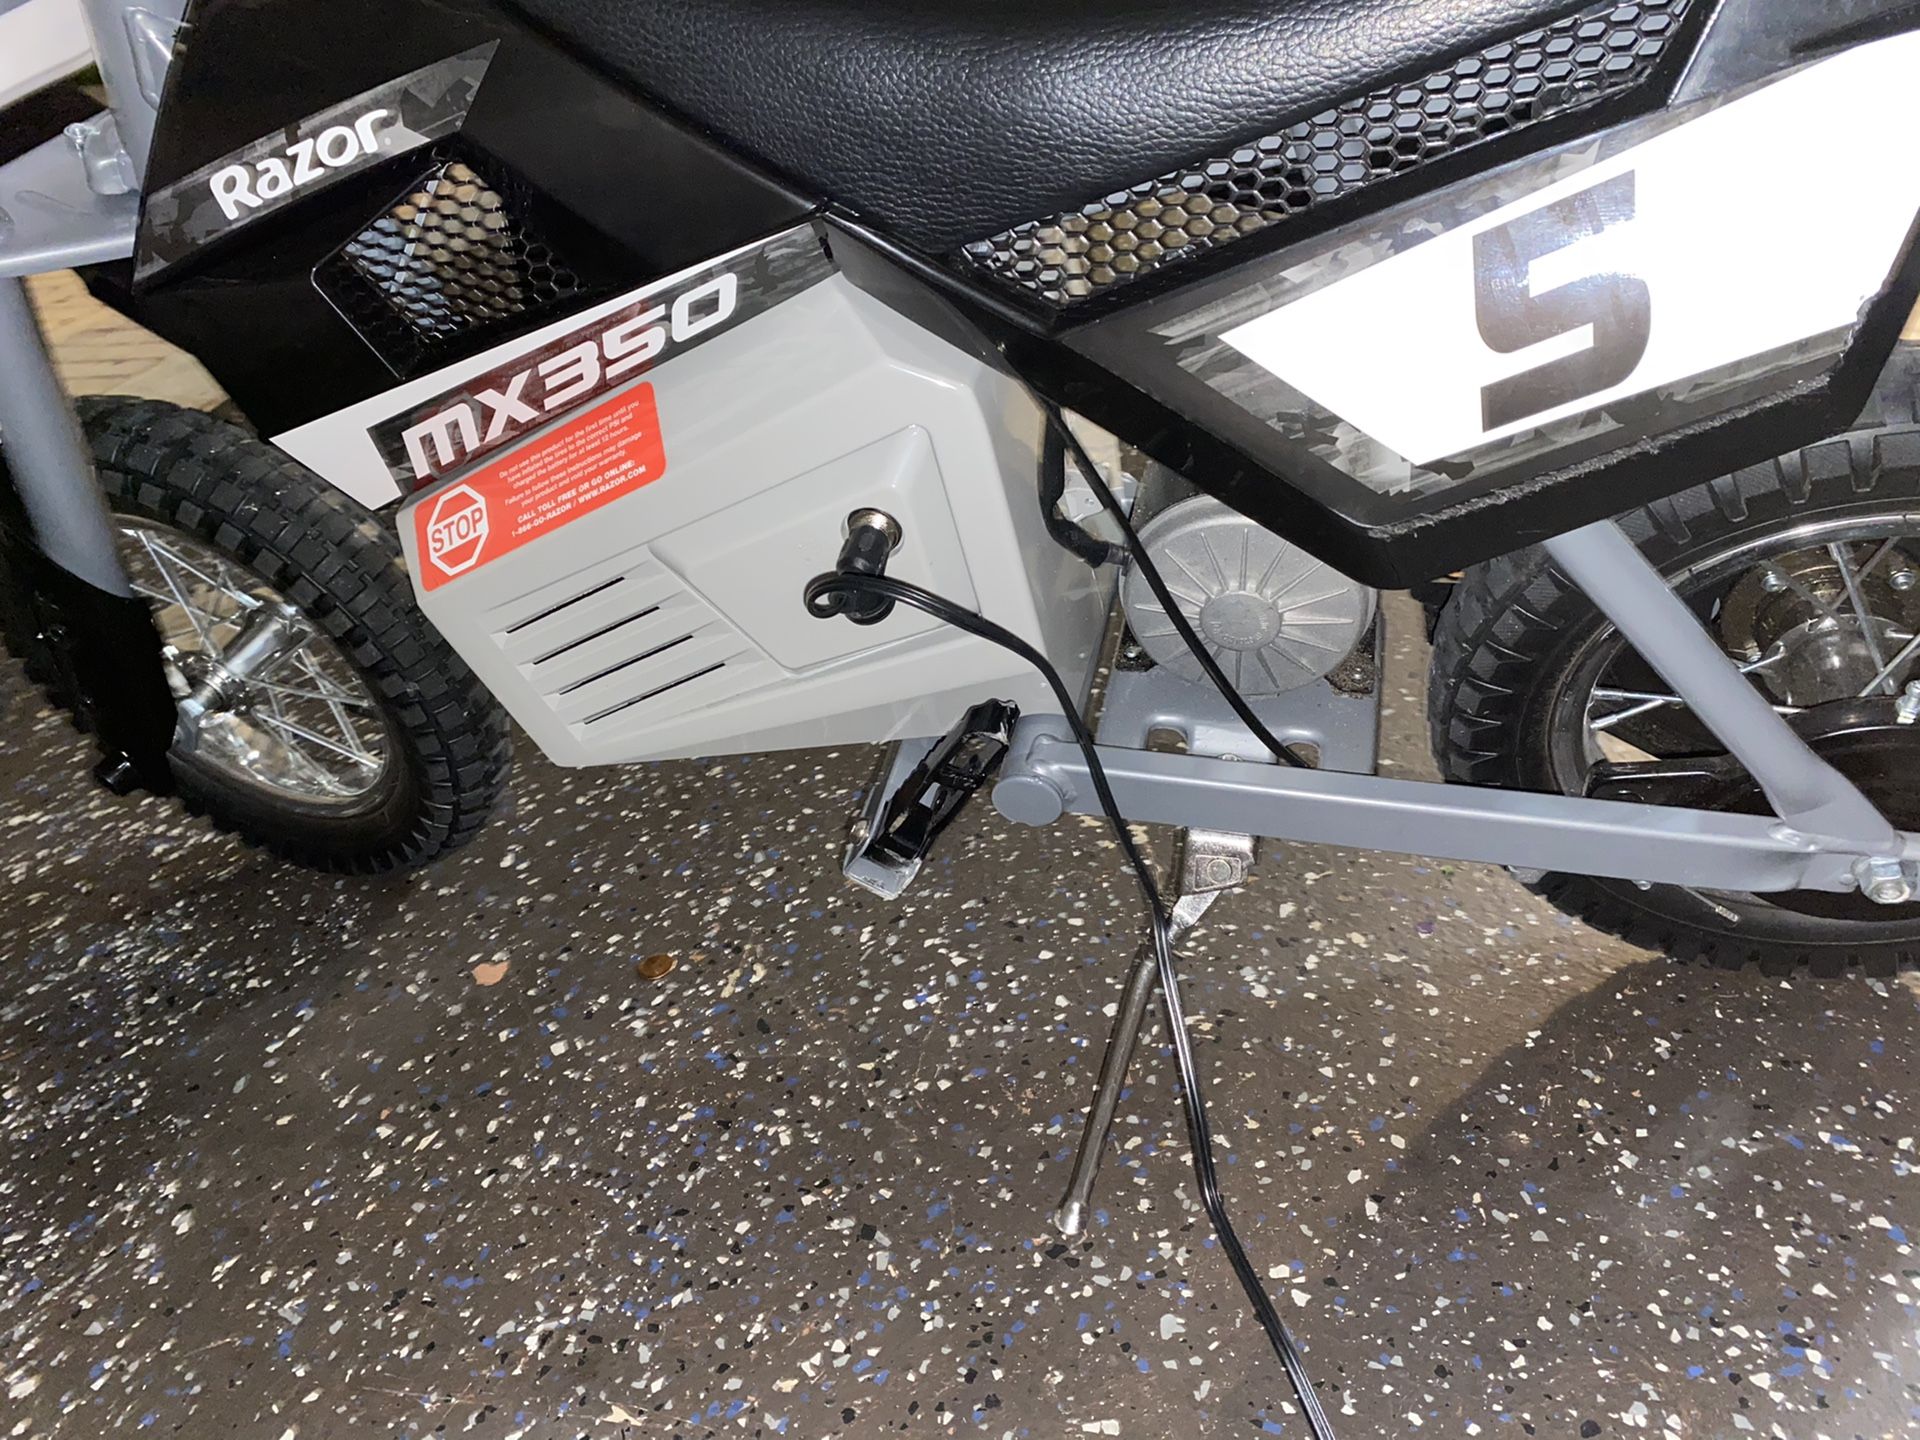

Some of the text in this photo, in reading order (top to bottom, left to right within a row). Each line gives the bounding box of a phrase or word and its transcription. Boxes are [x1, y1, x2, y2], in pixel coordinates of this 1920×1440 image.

[209, 108, 390, 221] Razor
[498, 468, 508, 479] Do
[507, 462, 518, 474] not
[528, 450, 541, 463] this
[540, 438, 565, 458] product
[573, 427, 585, 439] the
[584, 420, 598, 433] first
[597, 413, 612, 426] time
[611, 405, 627, 419] until
[626, 398, 640, 412] you
[504, 490, 524, 507] Failure
[530, 477, 550, 493] follow
[549, 468, 566, 483] these
[566, 450, 602, 475] instructions
[602, 442, 617, 457] may
[616, 429, 642, 450] damage
[511, 471, 537, 491] charged
[536, 466, 547, 477] the
[546, 455, 568, 473] battery
[577, 446, 585, 456] at
[584, 437, 601, 452] least
[600, 433, 609, 443] 12
[608, 422, 629, 439] hours.
[543, 453, 553, 464] the
[575, 436, 586, 447] the
[585, 424, 608, 442] correct
[607, 418, 620, 430] PSI
[619, 411, 633, 424] and
[516, 457, 636, 524] CALL TOLL FREE OR GO ONLINE:
[520, 495, 535, 509] your
[534, 483, 558, 502] product
[557, 476, 570, 489] and
[569, 469, 584, 482] void
[583, 461, 598, 477] your
[571, 498, 577, 508] /
[576, 462, 646, 505] WWW.RAZOR.COM
[431, 507, 485, 553] STOP
